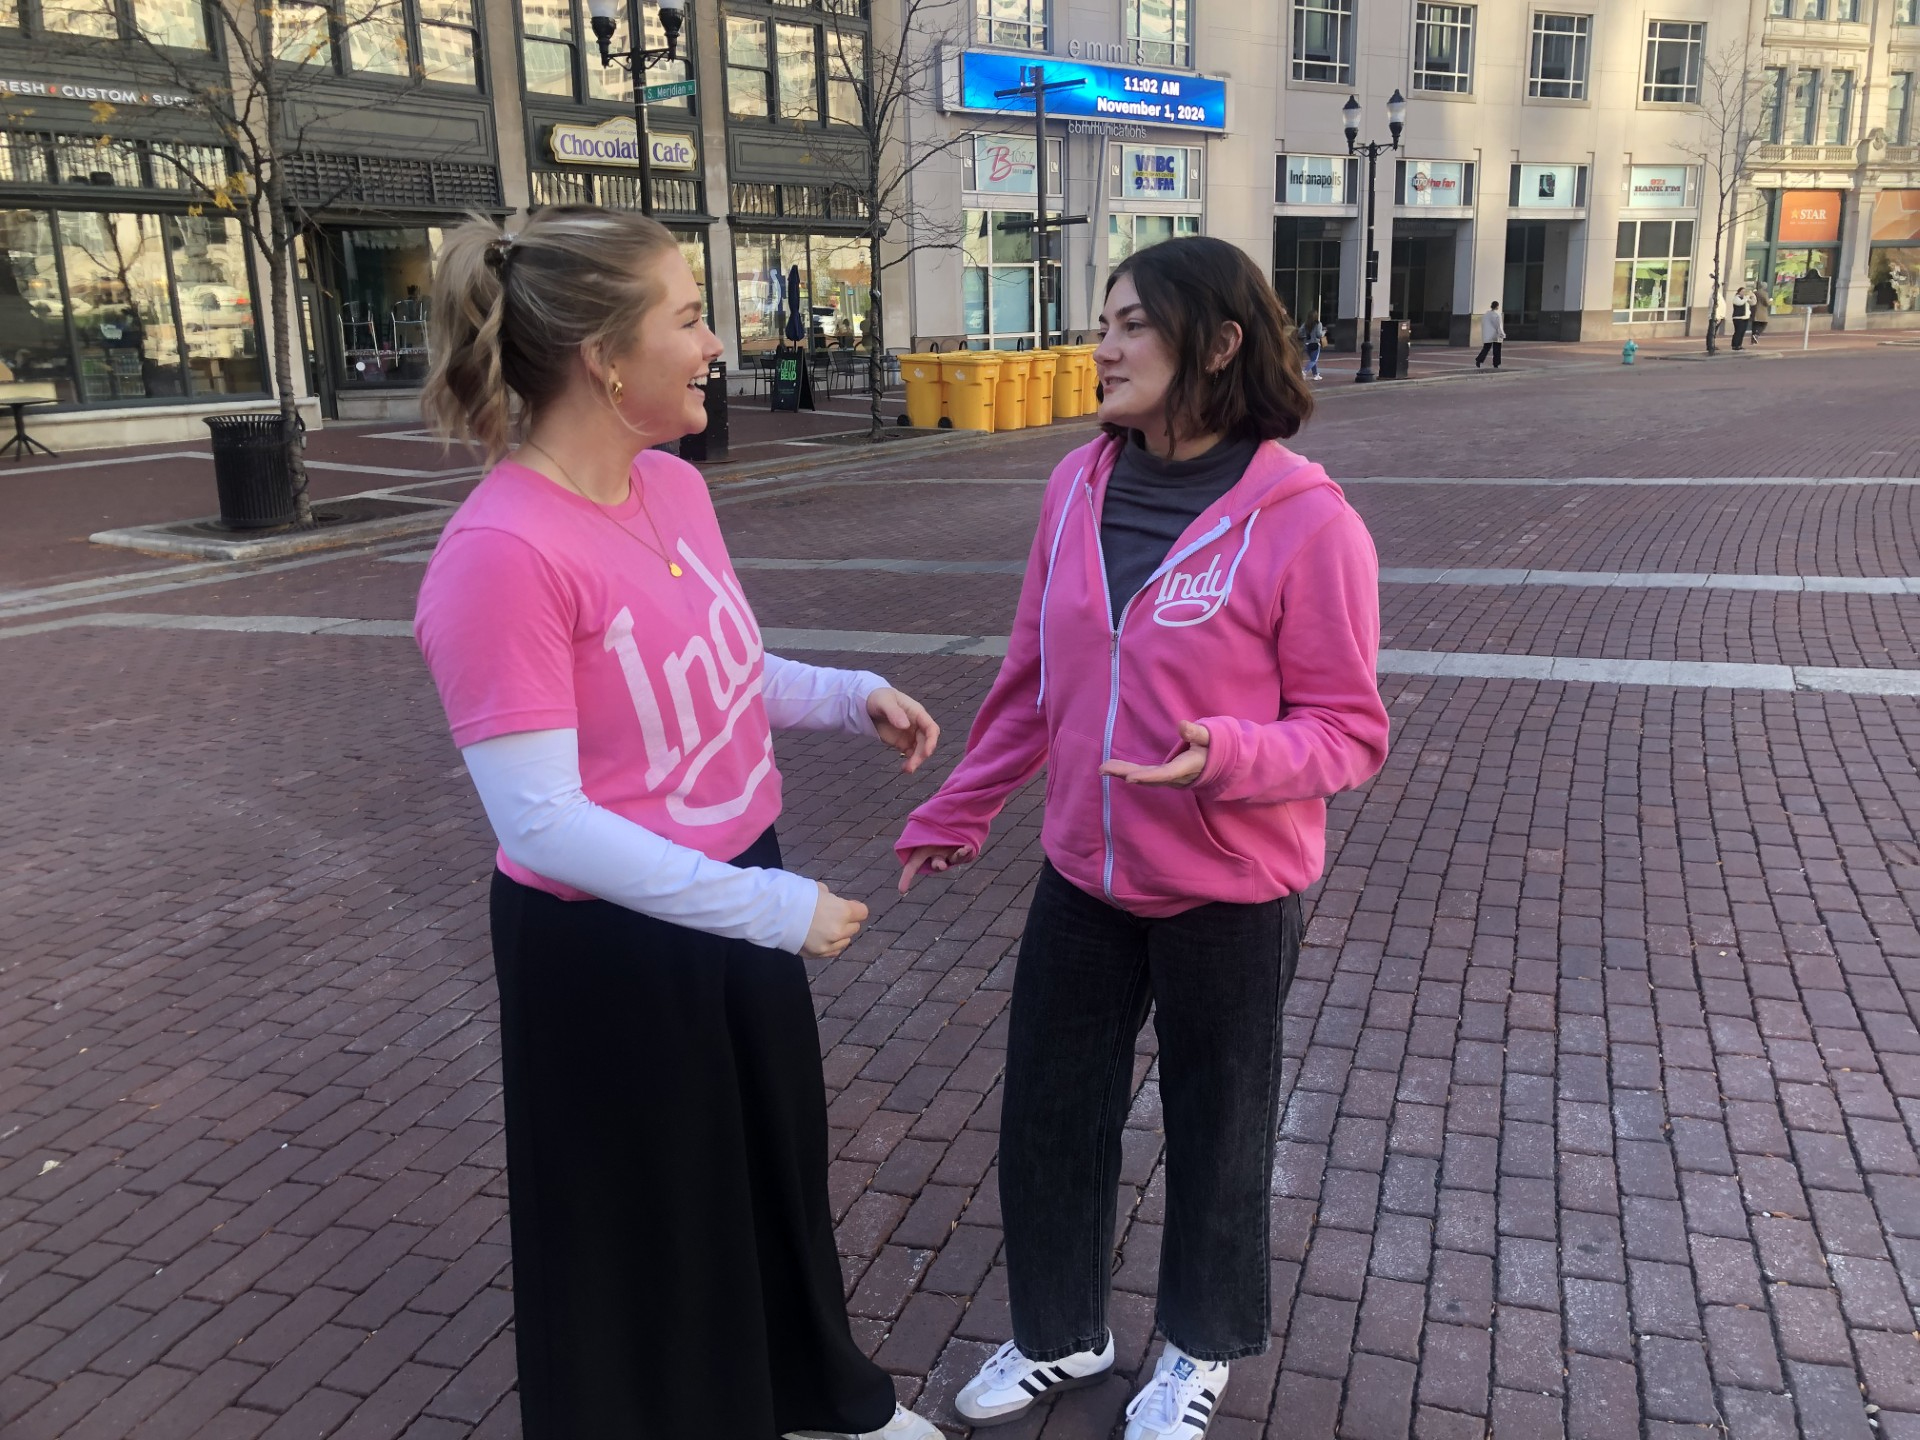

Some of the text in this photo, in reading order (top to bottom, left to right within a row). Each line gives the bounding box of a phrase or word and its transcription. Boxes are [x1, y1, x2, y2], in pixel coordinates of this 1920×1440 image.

[1068, 38, 1146, 66] emmis
[0, 80, 45, 94] RESH
[61, 85, 137, 103] CUSTOM
[657, 84, 687, 98] Meridian
[1123, 76, 1180, 96] 11:02 AM
[1097, 97, 1205, 122] November 1, 2024
[1068, 120, 1147, 139] communications
[559, 133, 690, 164] Chocolat Cafe
[1135, 154, 1175, 173] WIBC
[1289, 169, 1342, 189] Indianapolis
[1442, 178, 1456, 188] fan
[1800, 208, 1827, 220] STAR
[780, 370, 797, 381] BEND
[1152, 553, 1227, 628] Indy
